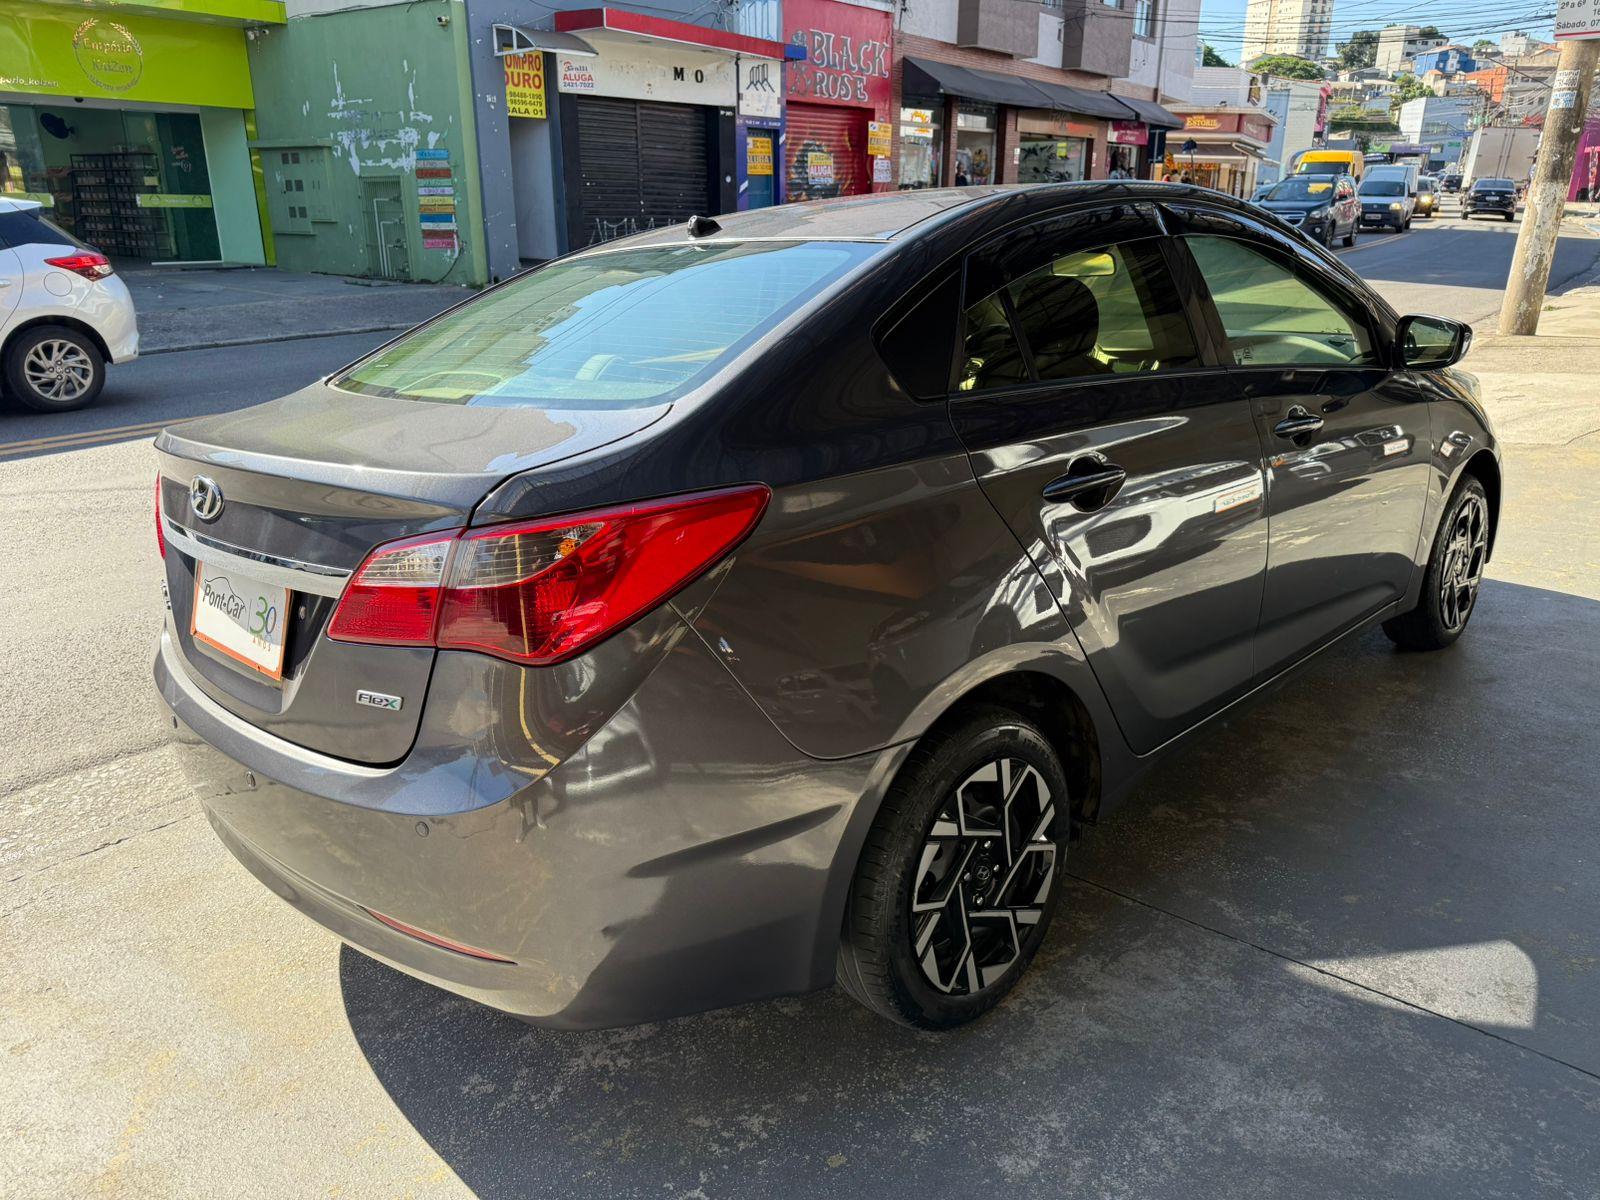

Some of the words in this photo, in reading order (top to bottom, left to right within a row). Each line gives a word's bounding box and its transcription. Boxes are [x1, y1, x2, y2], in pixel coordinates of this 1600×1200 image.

[1556, 20, 1586, 29] Sábado
[809, 28, 889, 79] BLACK
[504, 53, 541, 72] OMPRO
[562, 73, 594, 82] ALUGA
[813, 71, 869, 102] ROSE
[533, 108, 543, 116] 01
[250, 596, 277, 634] 30
[358, 693, 398, 709] Flex
